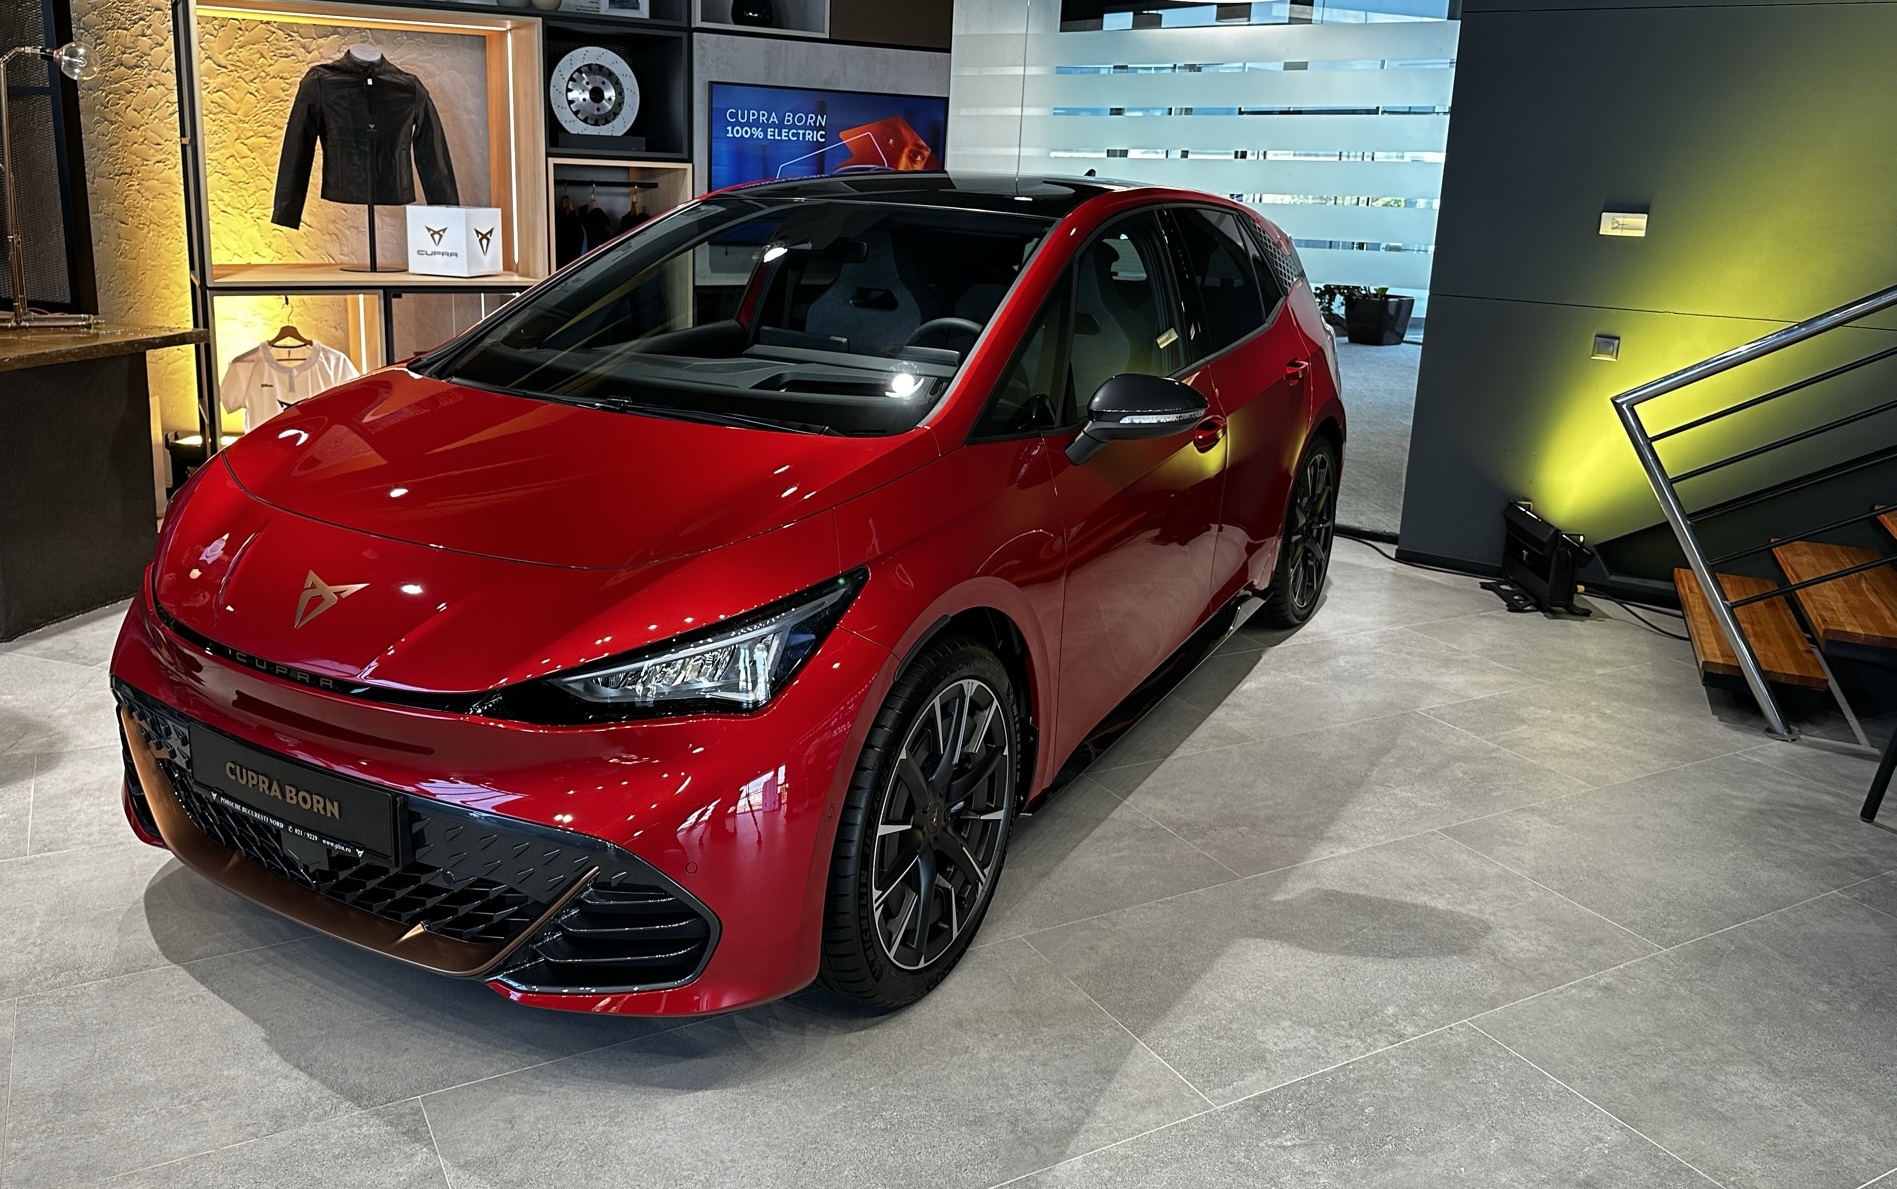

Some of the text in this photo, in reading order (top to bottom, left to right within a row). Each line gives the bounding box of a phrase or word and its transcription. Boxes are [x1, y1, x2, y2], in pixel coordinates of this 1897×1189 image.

[726, 109, 827, 127] CUPRA BORN
[726, 126, 826, 142] 100% ELECTRIC
[236, 651, 333, 689] CUPRA
[225, 761, 340, 820] CUPRA BORN
[220, 796, 241, 811] PORSCHE
[241, 806, 269, 822] BUCURESTI
[269, 818, 284, 829] NORD
